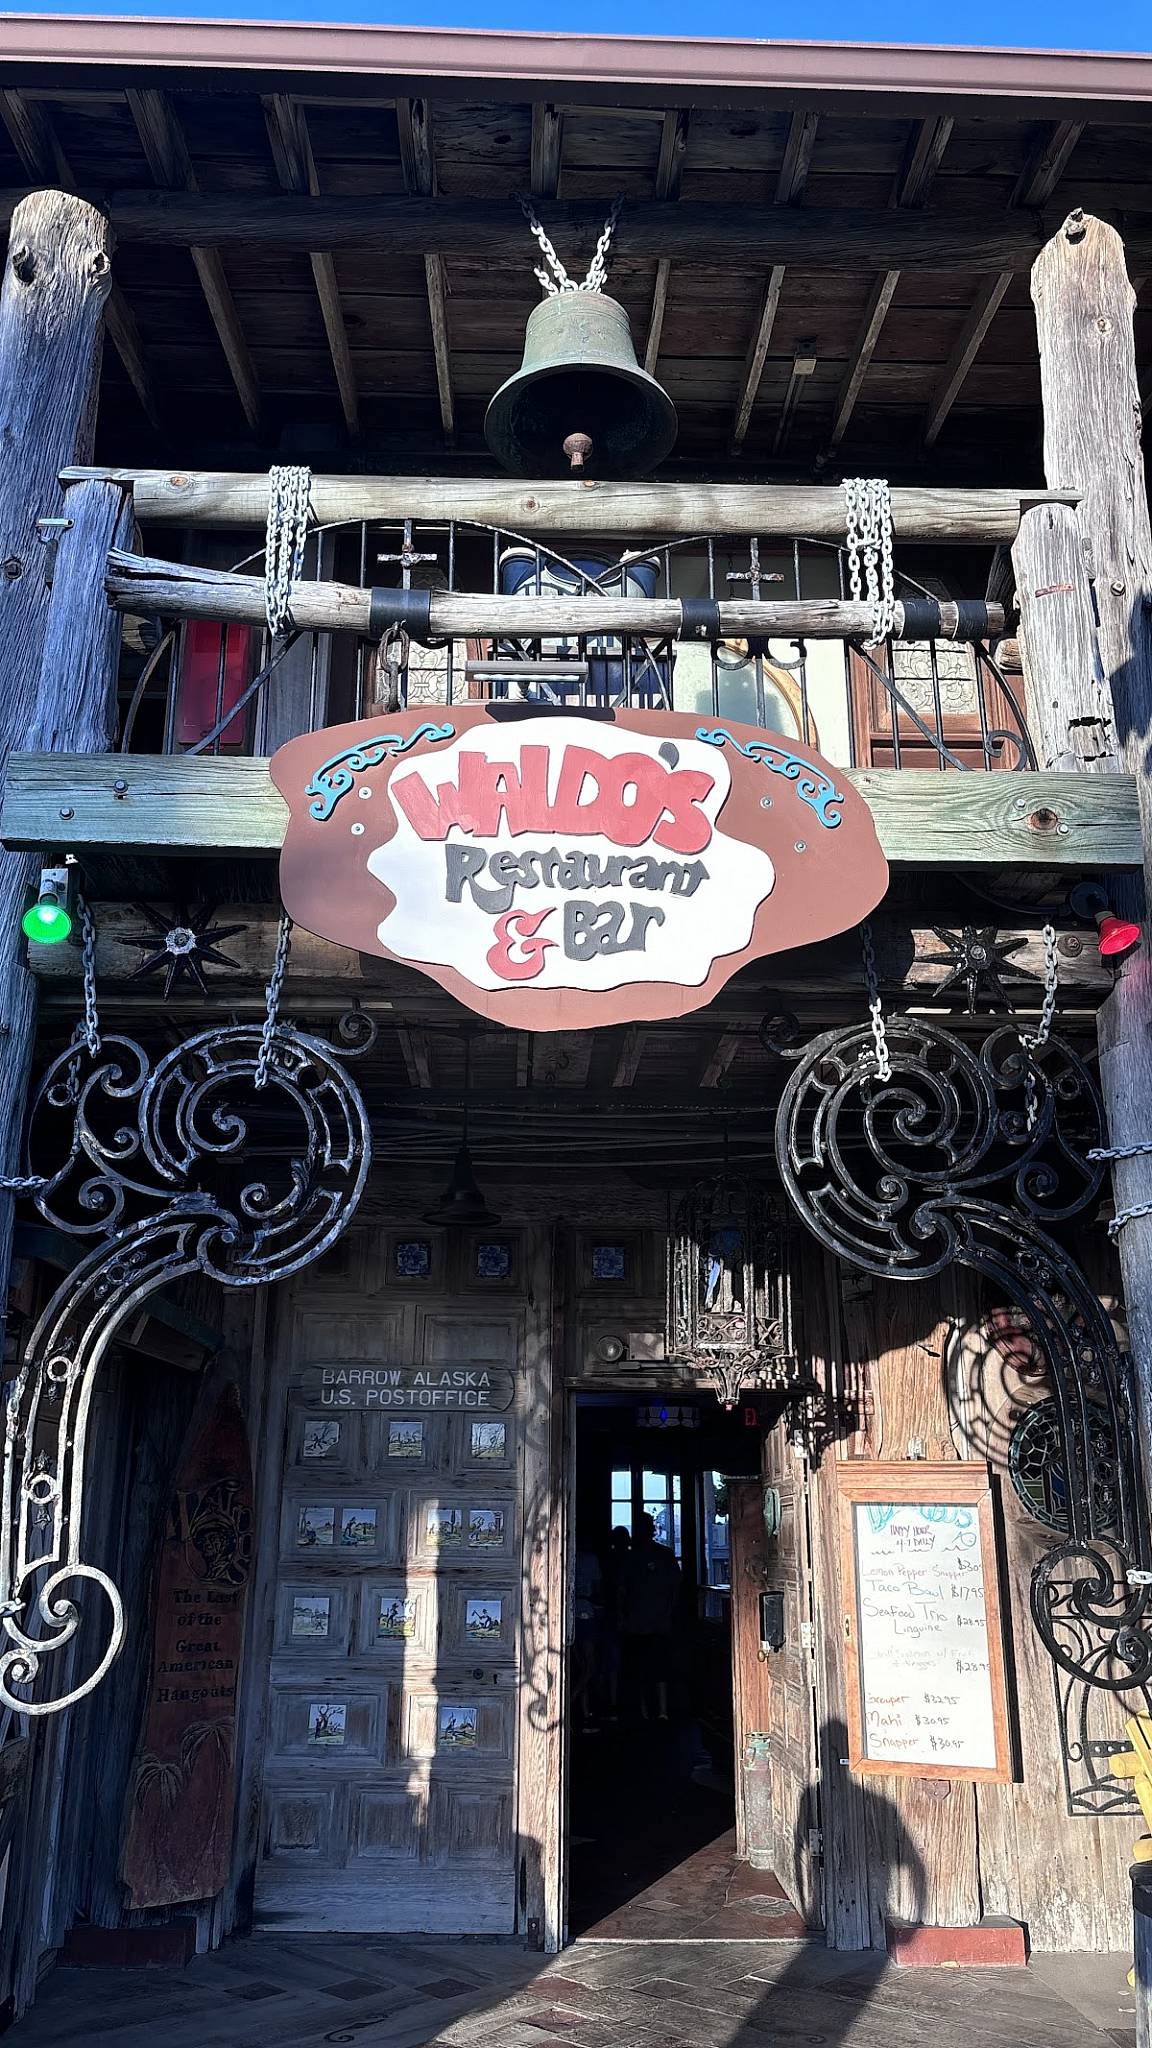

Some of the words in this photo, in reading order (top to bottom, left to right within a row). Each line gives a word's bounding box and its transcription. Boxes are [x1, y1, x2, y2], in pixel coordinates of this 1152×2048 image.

[390, 741, 716, 855] WALDO'S
[445, 843, 711, 915] Restaurant
[486, 906, 559, 981] &
[563, 900, 665, 961] Bar
[322, 1369, 401, 1386] BARROW
[413, 1371, 491, 1387] ALASKA
[320, 1389, 356, 1406] U.S.
[366, 1389, 491, 1407] POSTOFFICE
[862, 1560, 894, 1577] Lemon
[892, 1563, 928, 1581] Pepper
[864, 1579, 901, 1592] Taco
[173, 1589, 201, 1603] The
[175, 1640, 221, 1653] Great
[157, 1659, 233, 1673] American
[156, 1686, 235, 1704] Hangouts
[866, 1710, 903, 1728] Mahi
[870, 1733, 920, 1749] Snapper
